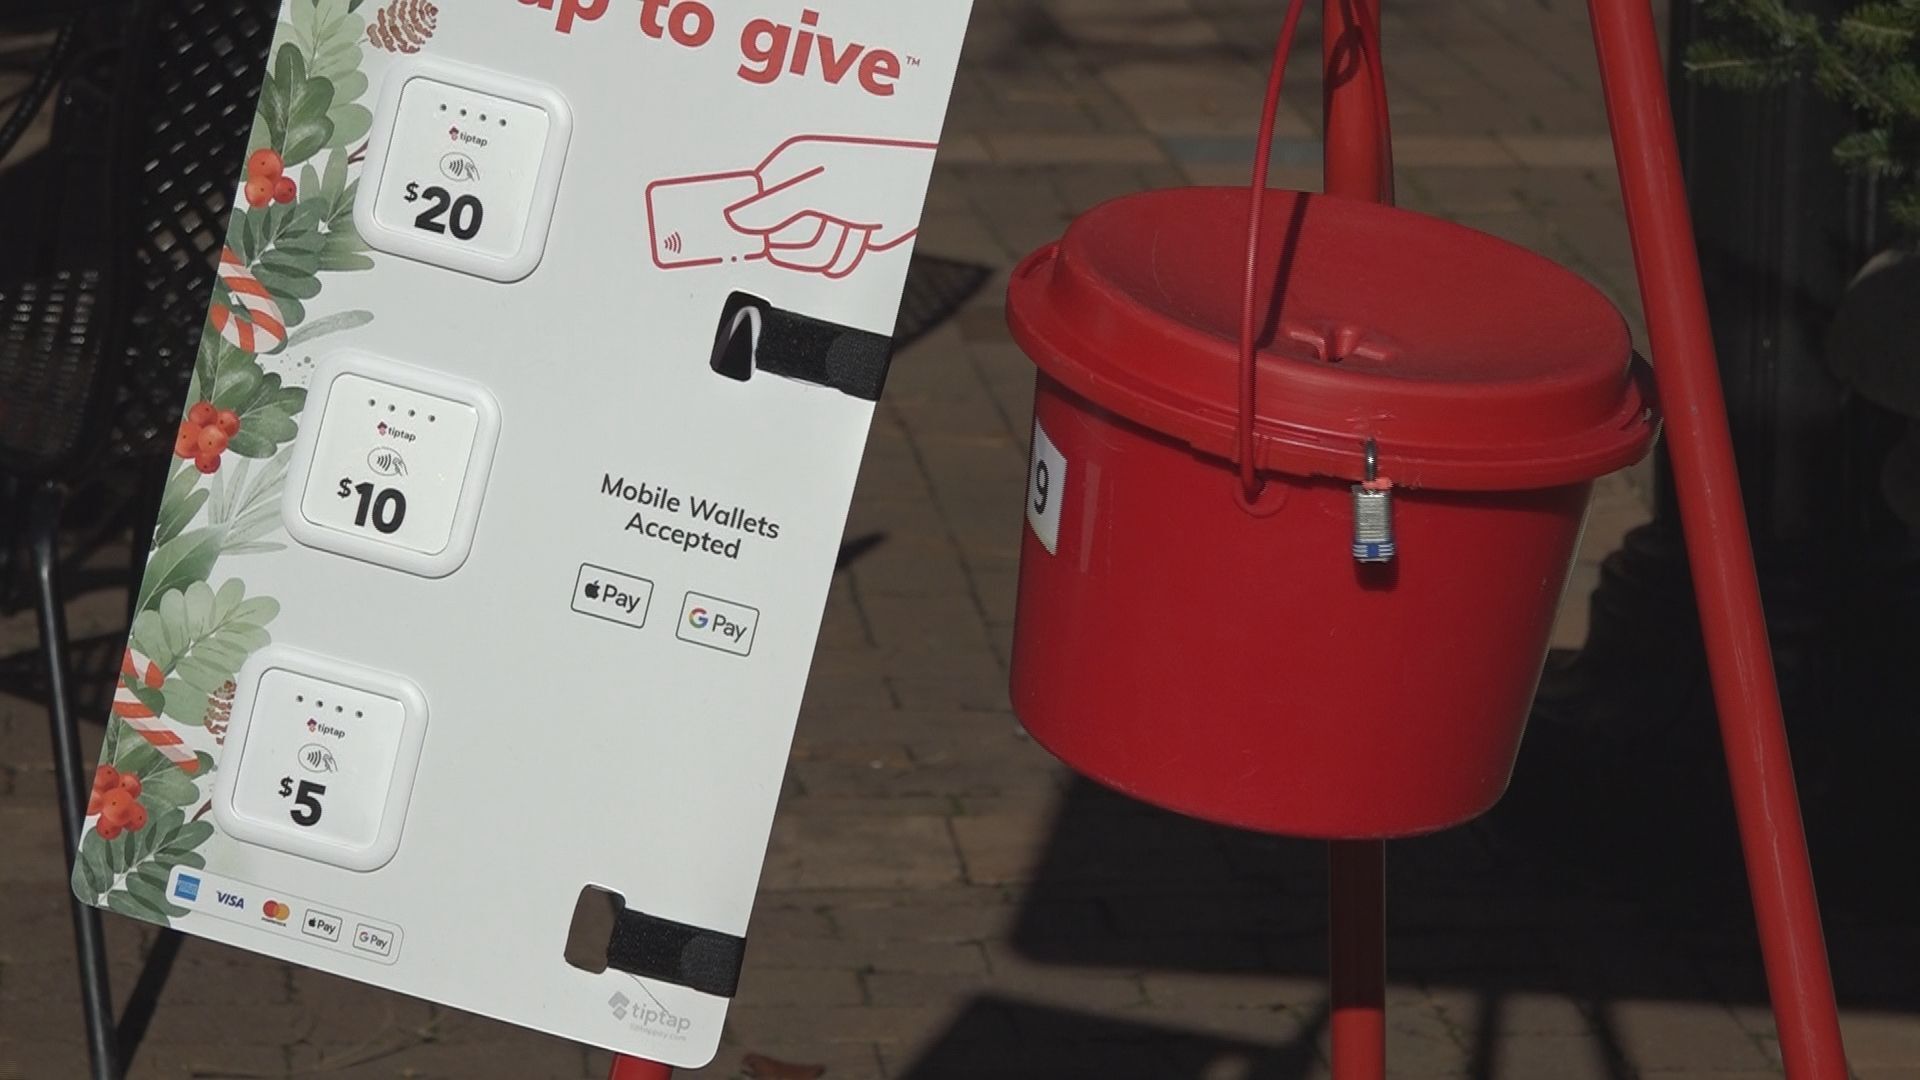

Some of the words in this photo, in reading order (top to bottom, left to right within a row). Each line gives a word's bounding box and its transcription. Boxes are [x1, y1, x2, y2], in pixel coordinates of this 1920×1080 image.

[517, 0, 610, 34] p
[639, 0, 715, 47] to
[737, 8, 901, 96] give
[460, 131, 488, 147] tiptap
[403, 181, 484, 241] $20
[388, 425, 416, 442] tiptap
[1033, 459, 1049, 515] 9
[337, 477, 407, 534] $10
[601, 473, 681, 512] Mobile
[690, 496, 780, 539] Wallets
[625, 512, 742, 559] Accepted
[602, 584, 641, 614] Pay
[712, 614, 747, 643] Pay
[318, 723, 345, 739] tiptap
[278, 776, 326, 827] $5
[216, 890, 245, 910] VISA
[317, 919, 337, 935] Pay
[370, 934, 388, 950] Pay
[632, 1003, 691, 1033] tiptap
